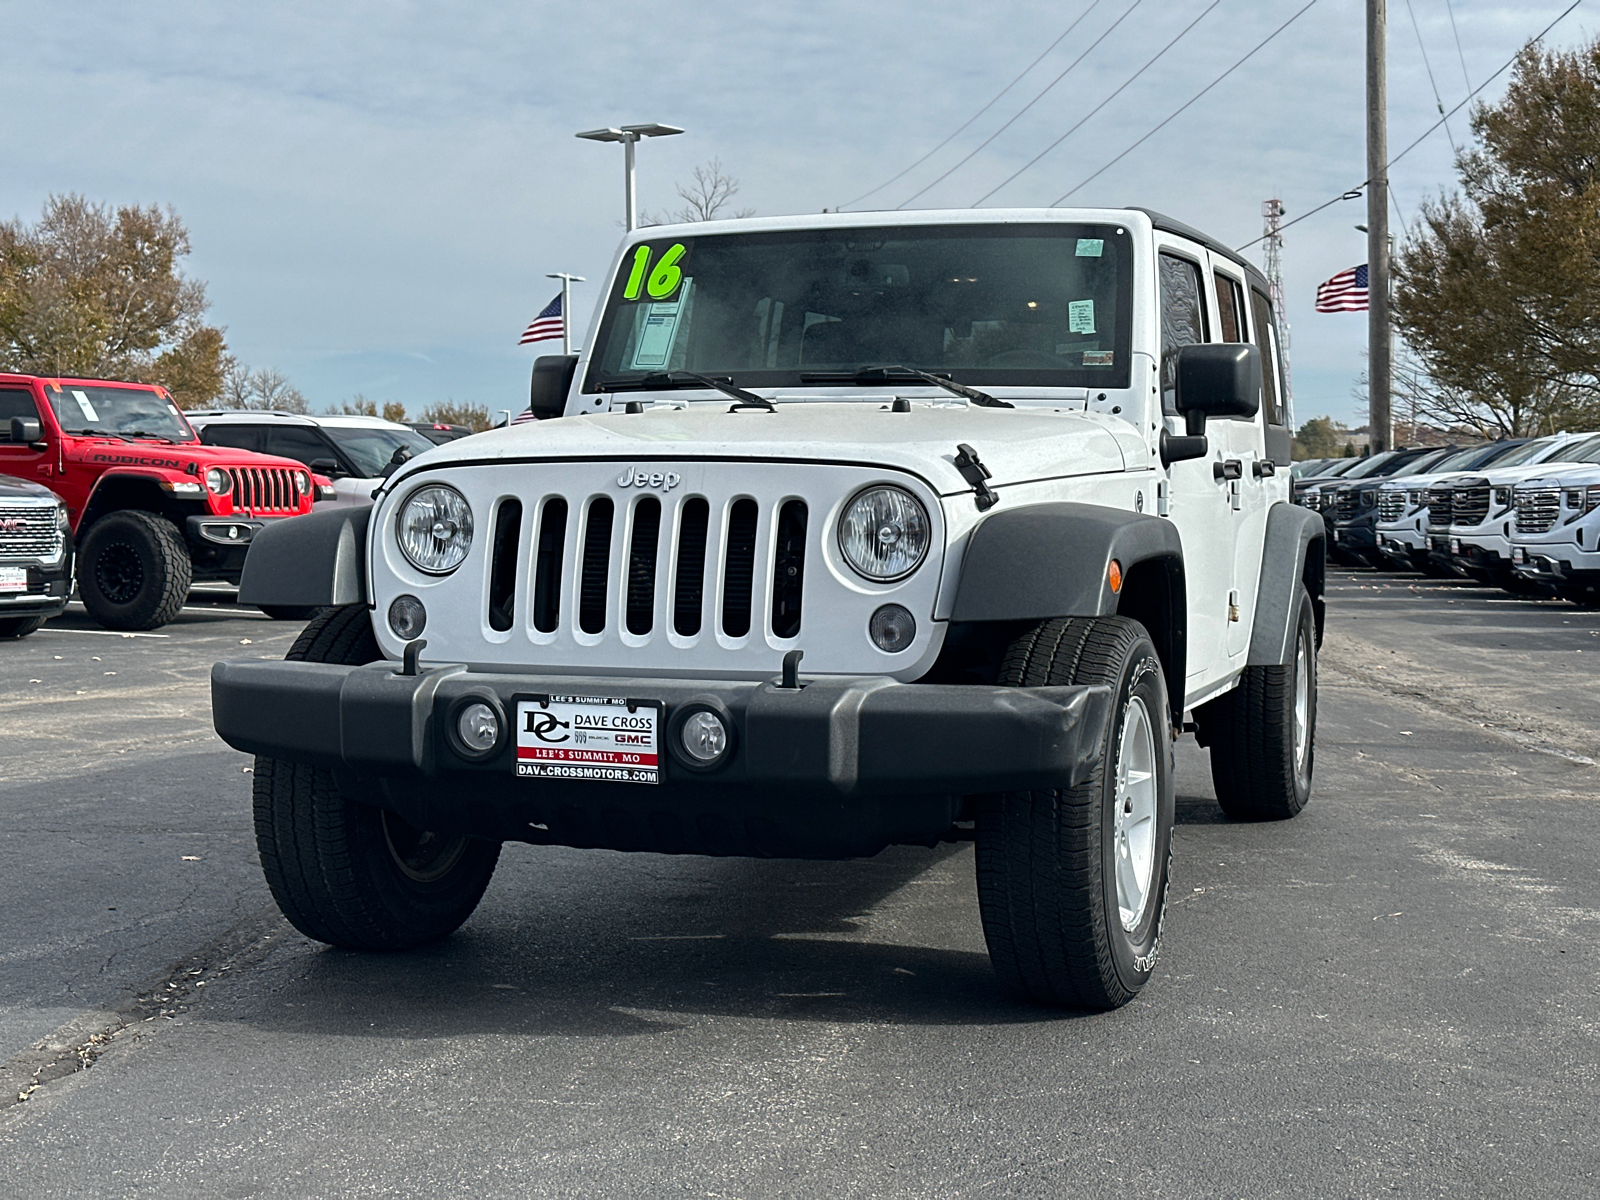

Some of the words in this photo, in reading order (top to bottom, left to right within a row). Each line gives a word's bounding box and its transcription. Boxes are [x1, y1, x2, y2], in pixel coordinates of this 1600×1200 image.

[623, 243, 687, 301] 16
[93, 454, 180, 467] RUBICON
[616, 466, 681, 492] Jeep
[0, 519, 27, 531] MC
[575, 696, 608, 704] SUMMIT
[574, 714, 608, 727] DAVE
[612, 716, 653, 729] CROSS
[615, 734, 652, 745] GMC
[535, 749, 565, 759] LEE'S
[568, 751, 618, 763] SUMMIT,
[622, 754, 641, 763] MO
